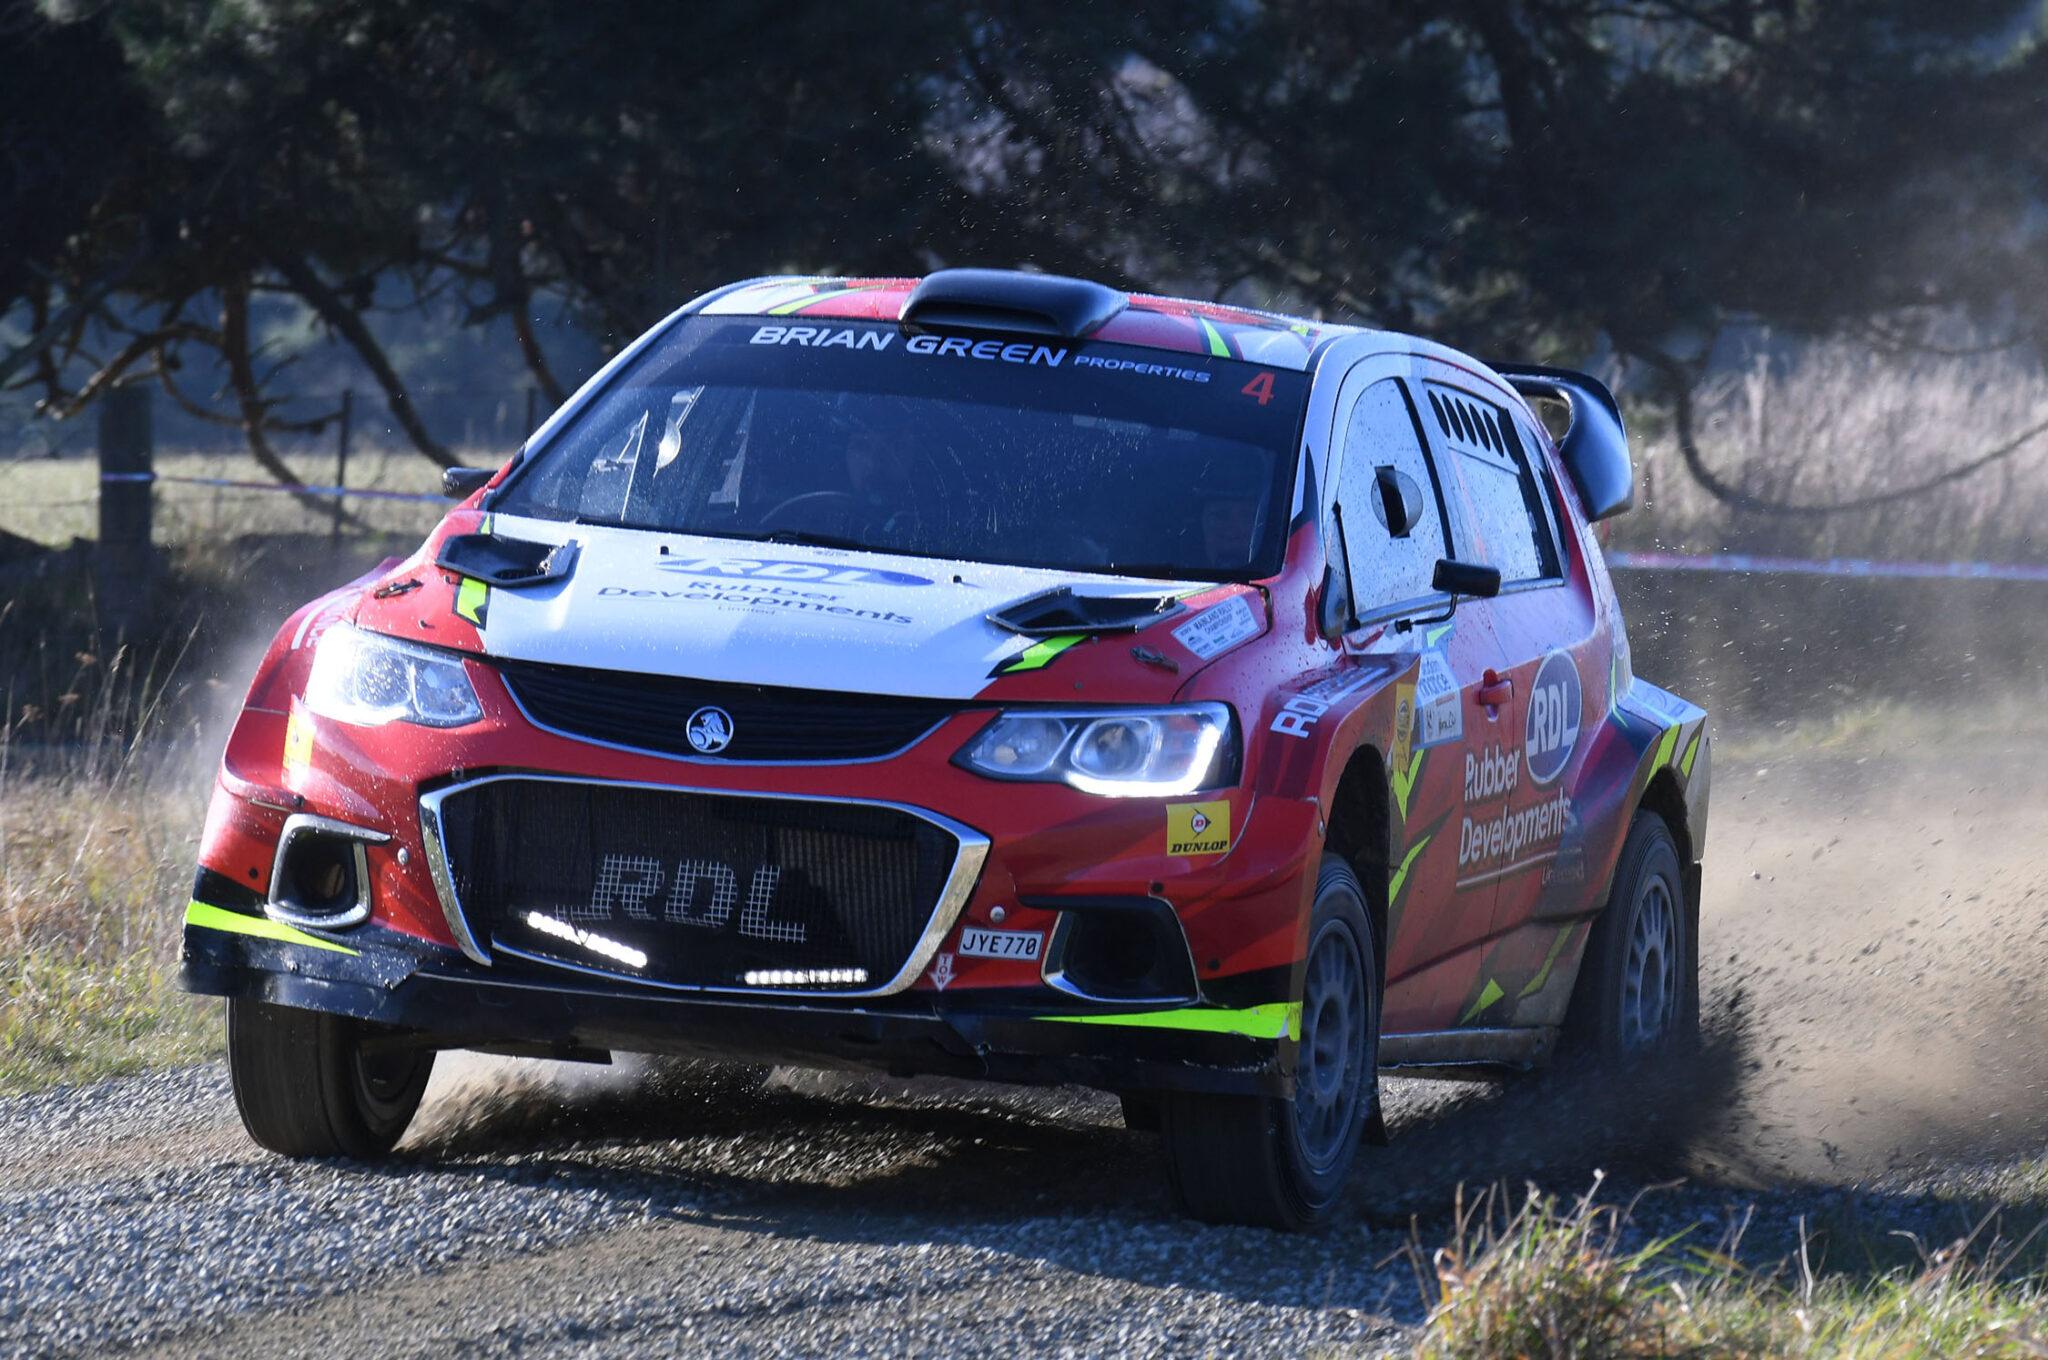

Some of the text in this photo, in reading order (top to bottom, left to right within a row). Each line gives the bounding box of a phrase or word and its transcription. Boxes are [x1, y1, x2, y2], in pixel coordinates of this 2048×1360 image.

[749, 327, 1212, 383] BRIAN GREEN PROPERTIES
[1241, 372, 1276, 406] 4
[660, 558, 878, 585] RDL
[598, 587, 914, 625] Developments
[689, 580, 846, 601] Rubber
[1527, 680, 1579, 757] RDL
[1464, 746, 1522, 803] Rubber
[1459, 787, 1579, 866] Developments
[1170, 840, 1228, 854] DUNLOP
[554, 853, 808, 943] RDL
[962, 933, 1038, 956] JYE770
[937, 956, 948, 985] TOW
